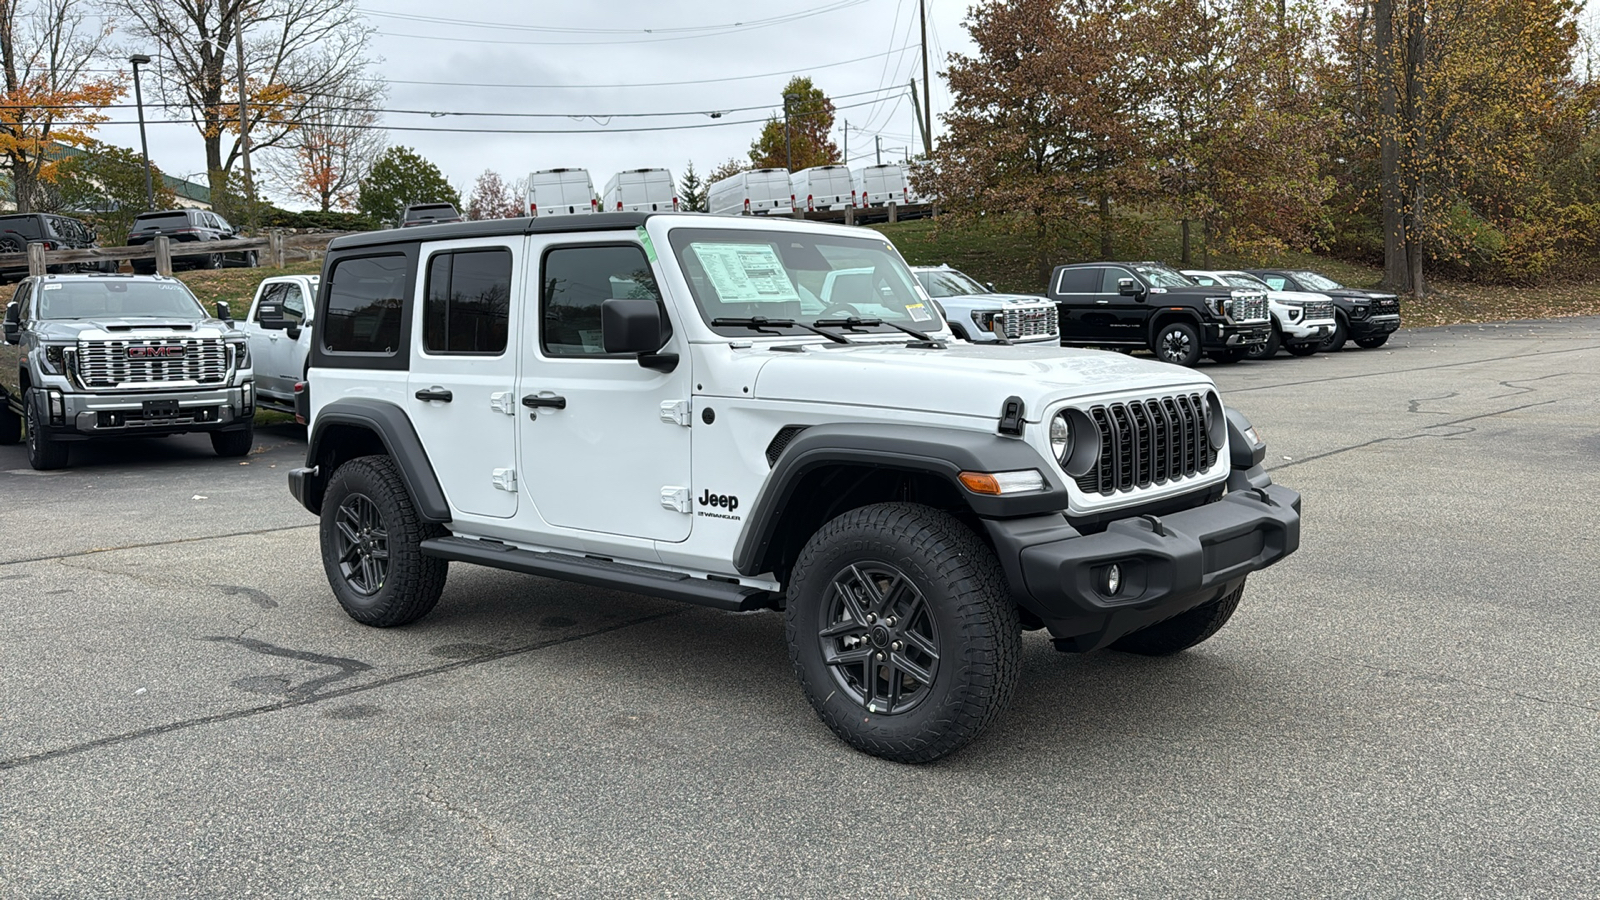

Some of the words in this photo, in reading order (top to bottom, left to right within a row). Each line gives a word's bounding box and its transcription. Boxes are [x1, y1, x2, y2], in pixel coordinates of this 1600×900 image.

[128, 346, 183, 358] GMC
[698, 489, 739, 512] Jeep
[704, 512, 741, 521] WRANGLER
